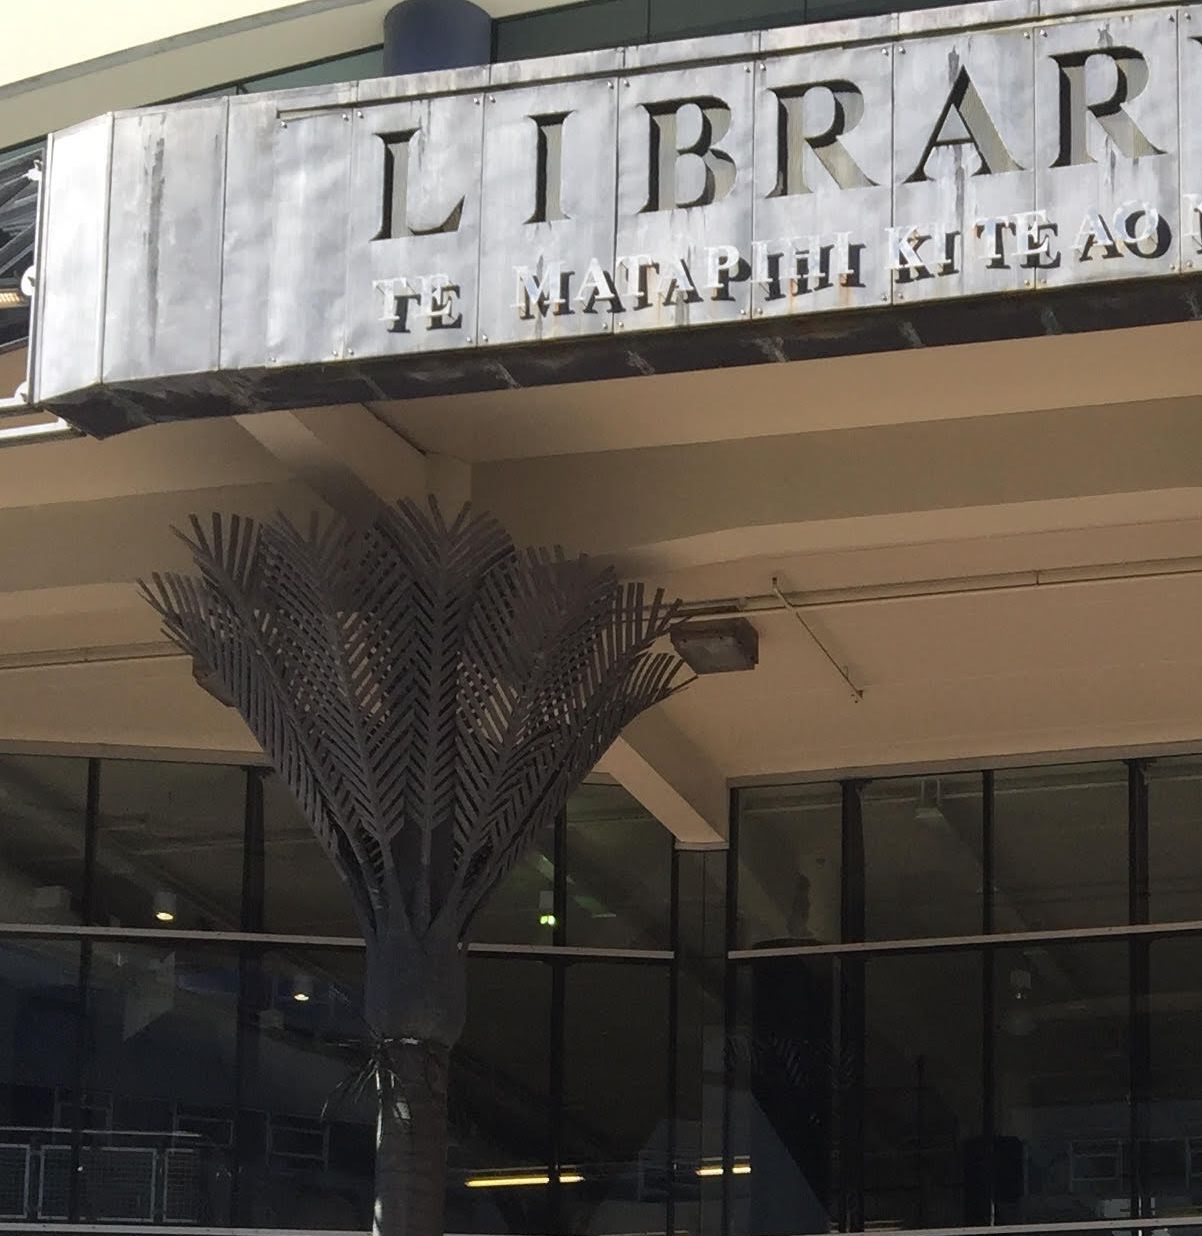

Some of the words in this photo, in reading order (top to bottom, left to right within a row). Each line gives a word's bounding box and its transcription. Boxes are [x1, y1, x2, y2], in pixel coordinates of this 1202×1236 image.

[372, 272, 459, 328] TE
[510, 230, 860, 314] MATAPIHI
[884, 218, 963, 276] KI
[972, 208, 1056, 266] TE
[1070, 199, 1166, 254] AO
